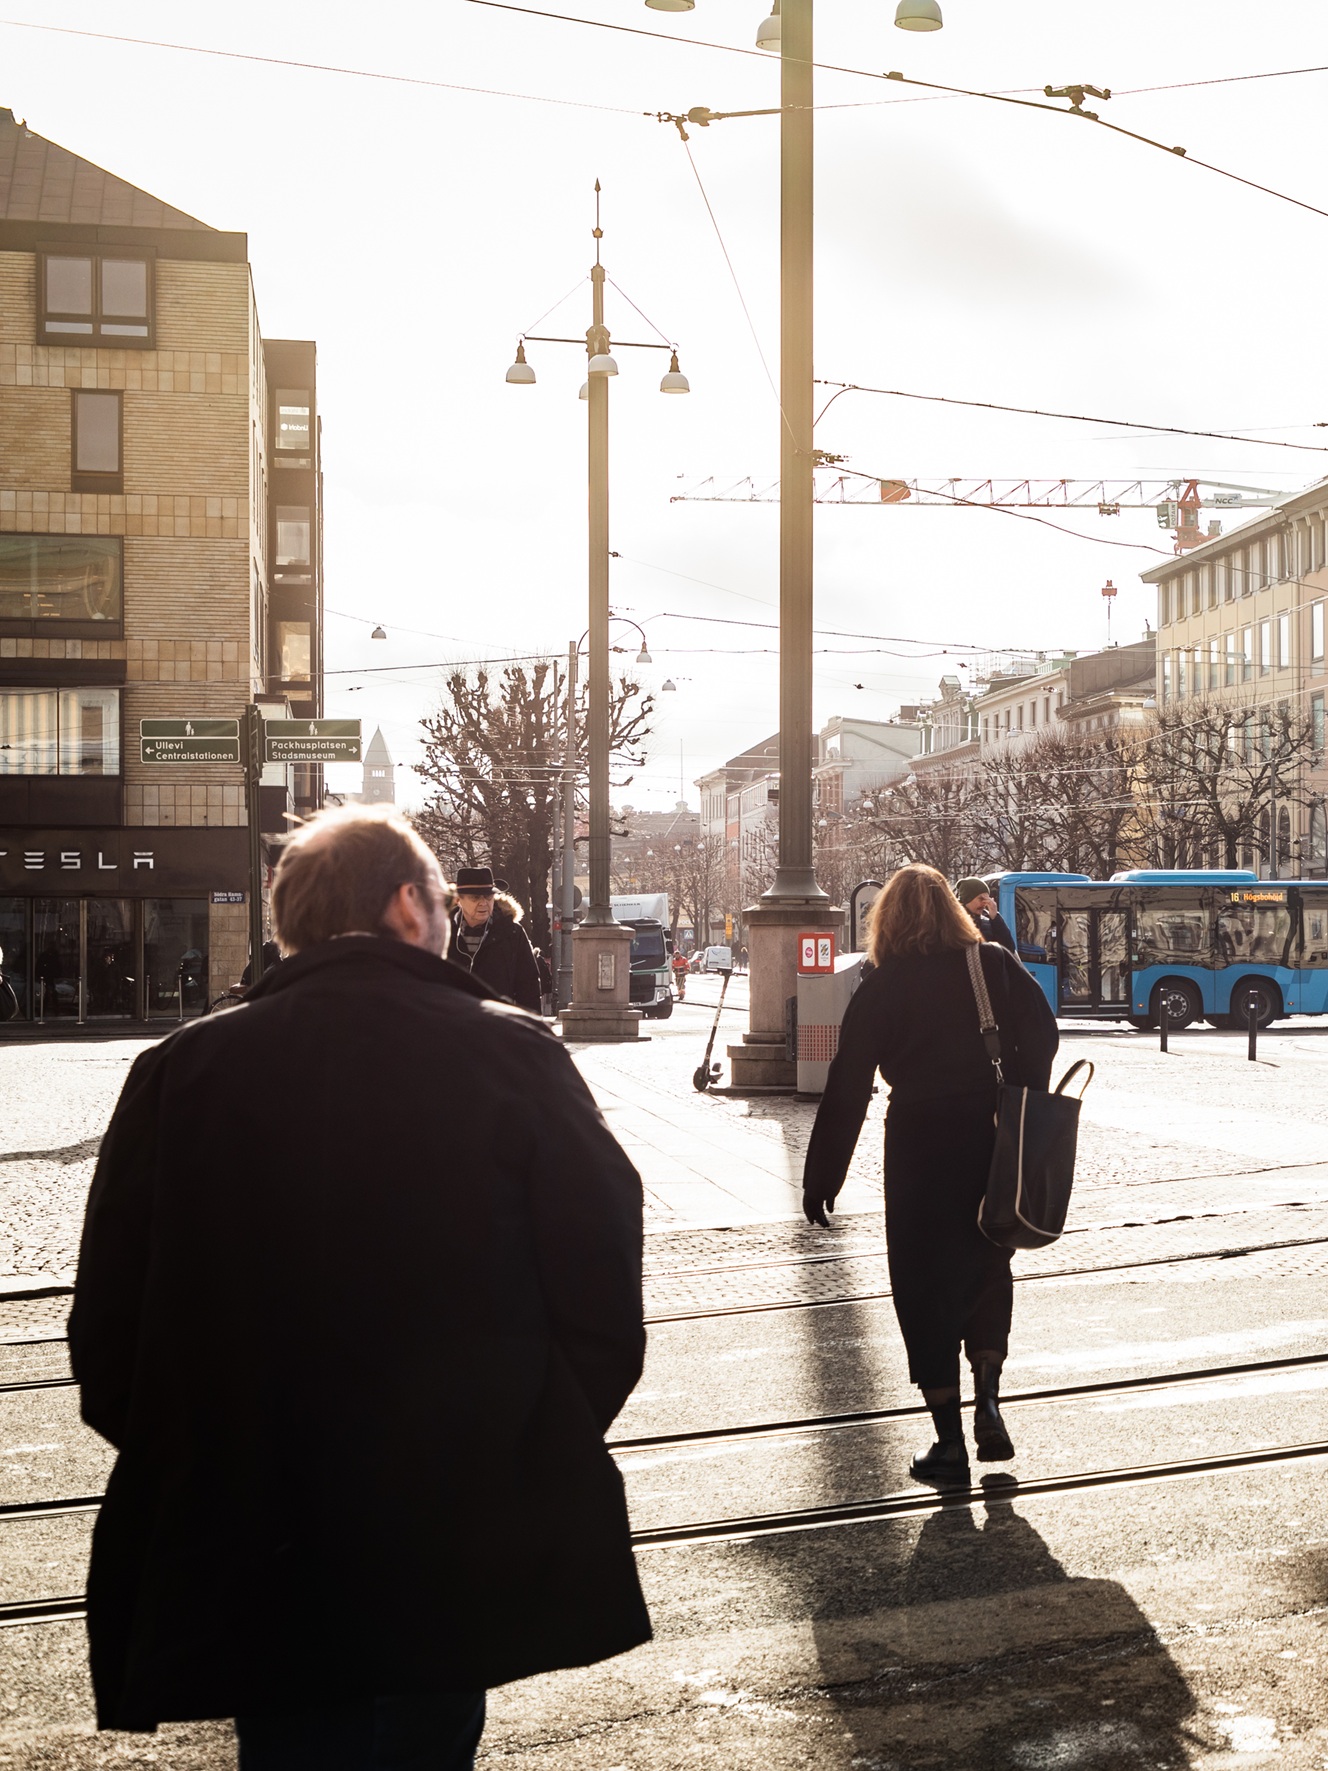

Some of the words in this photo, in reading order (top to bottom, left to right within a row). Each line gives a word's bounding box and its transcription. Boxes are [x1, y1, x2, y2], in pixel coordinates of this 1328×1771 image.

[155, 741, 184, 750] Ullevi
[271, 741, 347, 751] Packhusplatsen
[155, 751, 234, 760] Centralstationen
[272, 752, 336, 760] Stadsmuseum
[1231, 892, 1239, 902] 16
[1243, 892, 1283, 903] Högsbohöjd
